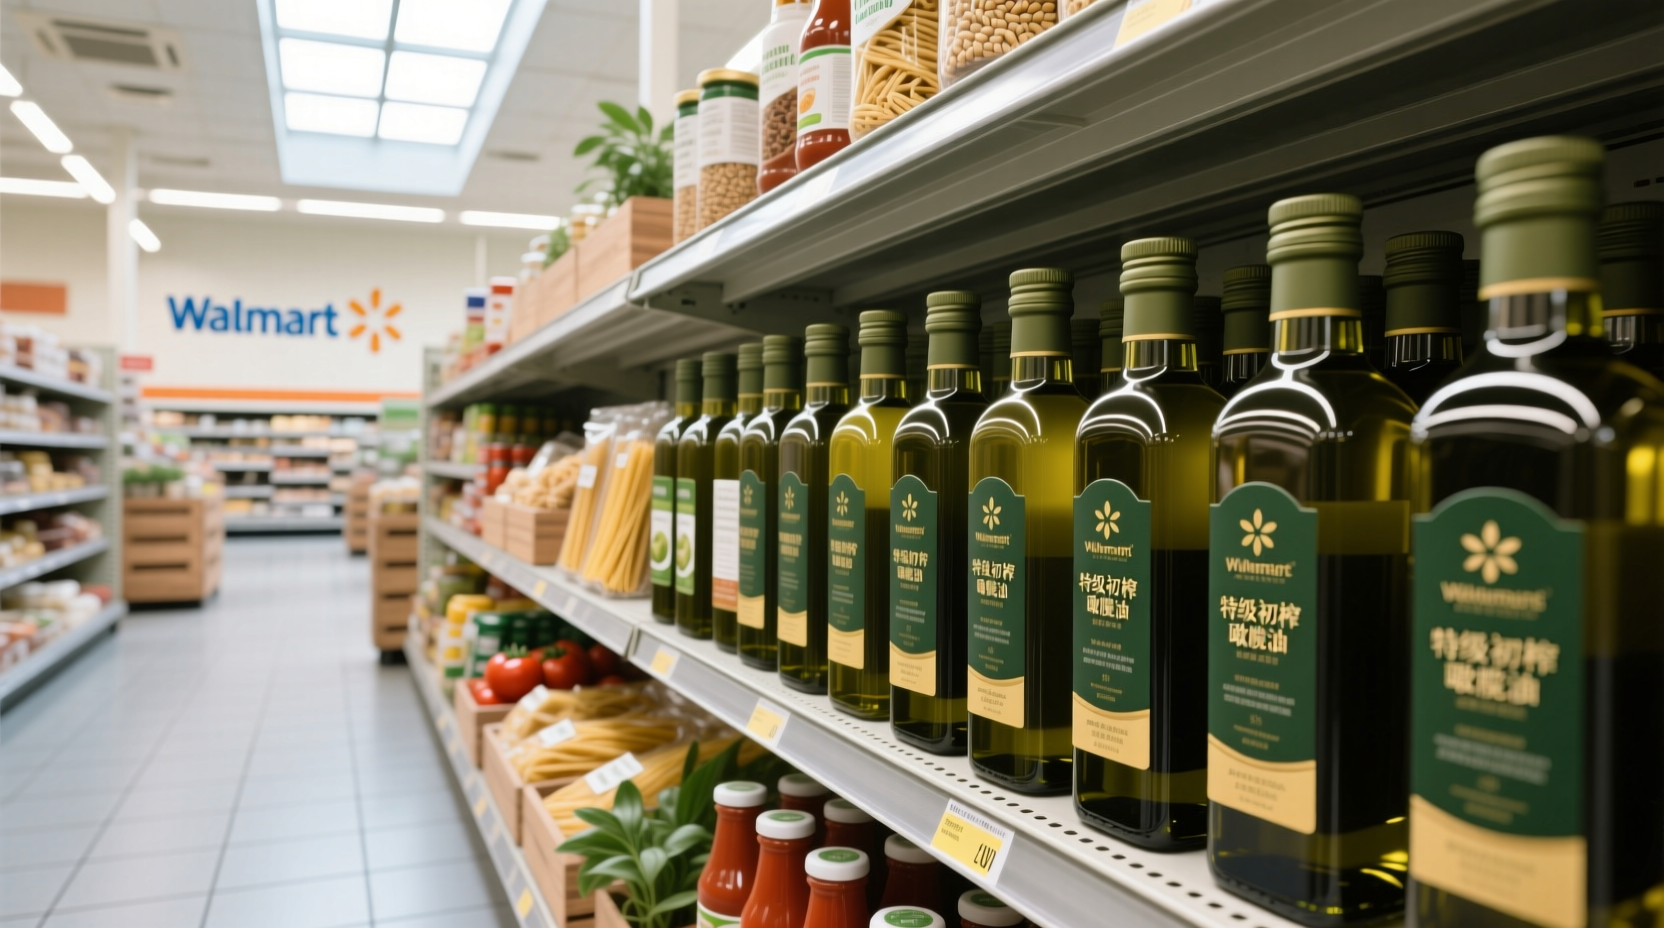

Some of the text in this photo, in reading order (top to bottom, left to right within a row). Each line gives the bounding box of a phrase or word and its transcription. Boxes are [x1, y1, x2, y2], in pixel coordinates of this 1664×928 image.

[167, 297, 338, 337] Walmart
[1220, 595, 1301, 629] 特级初榨
